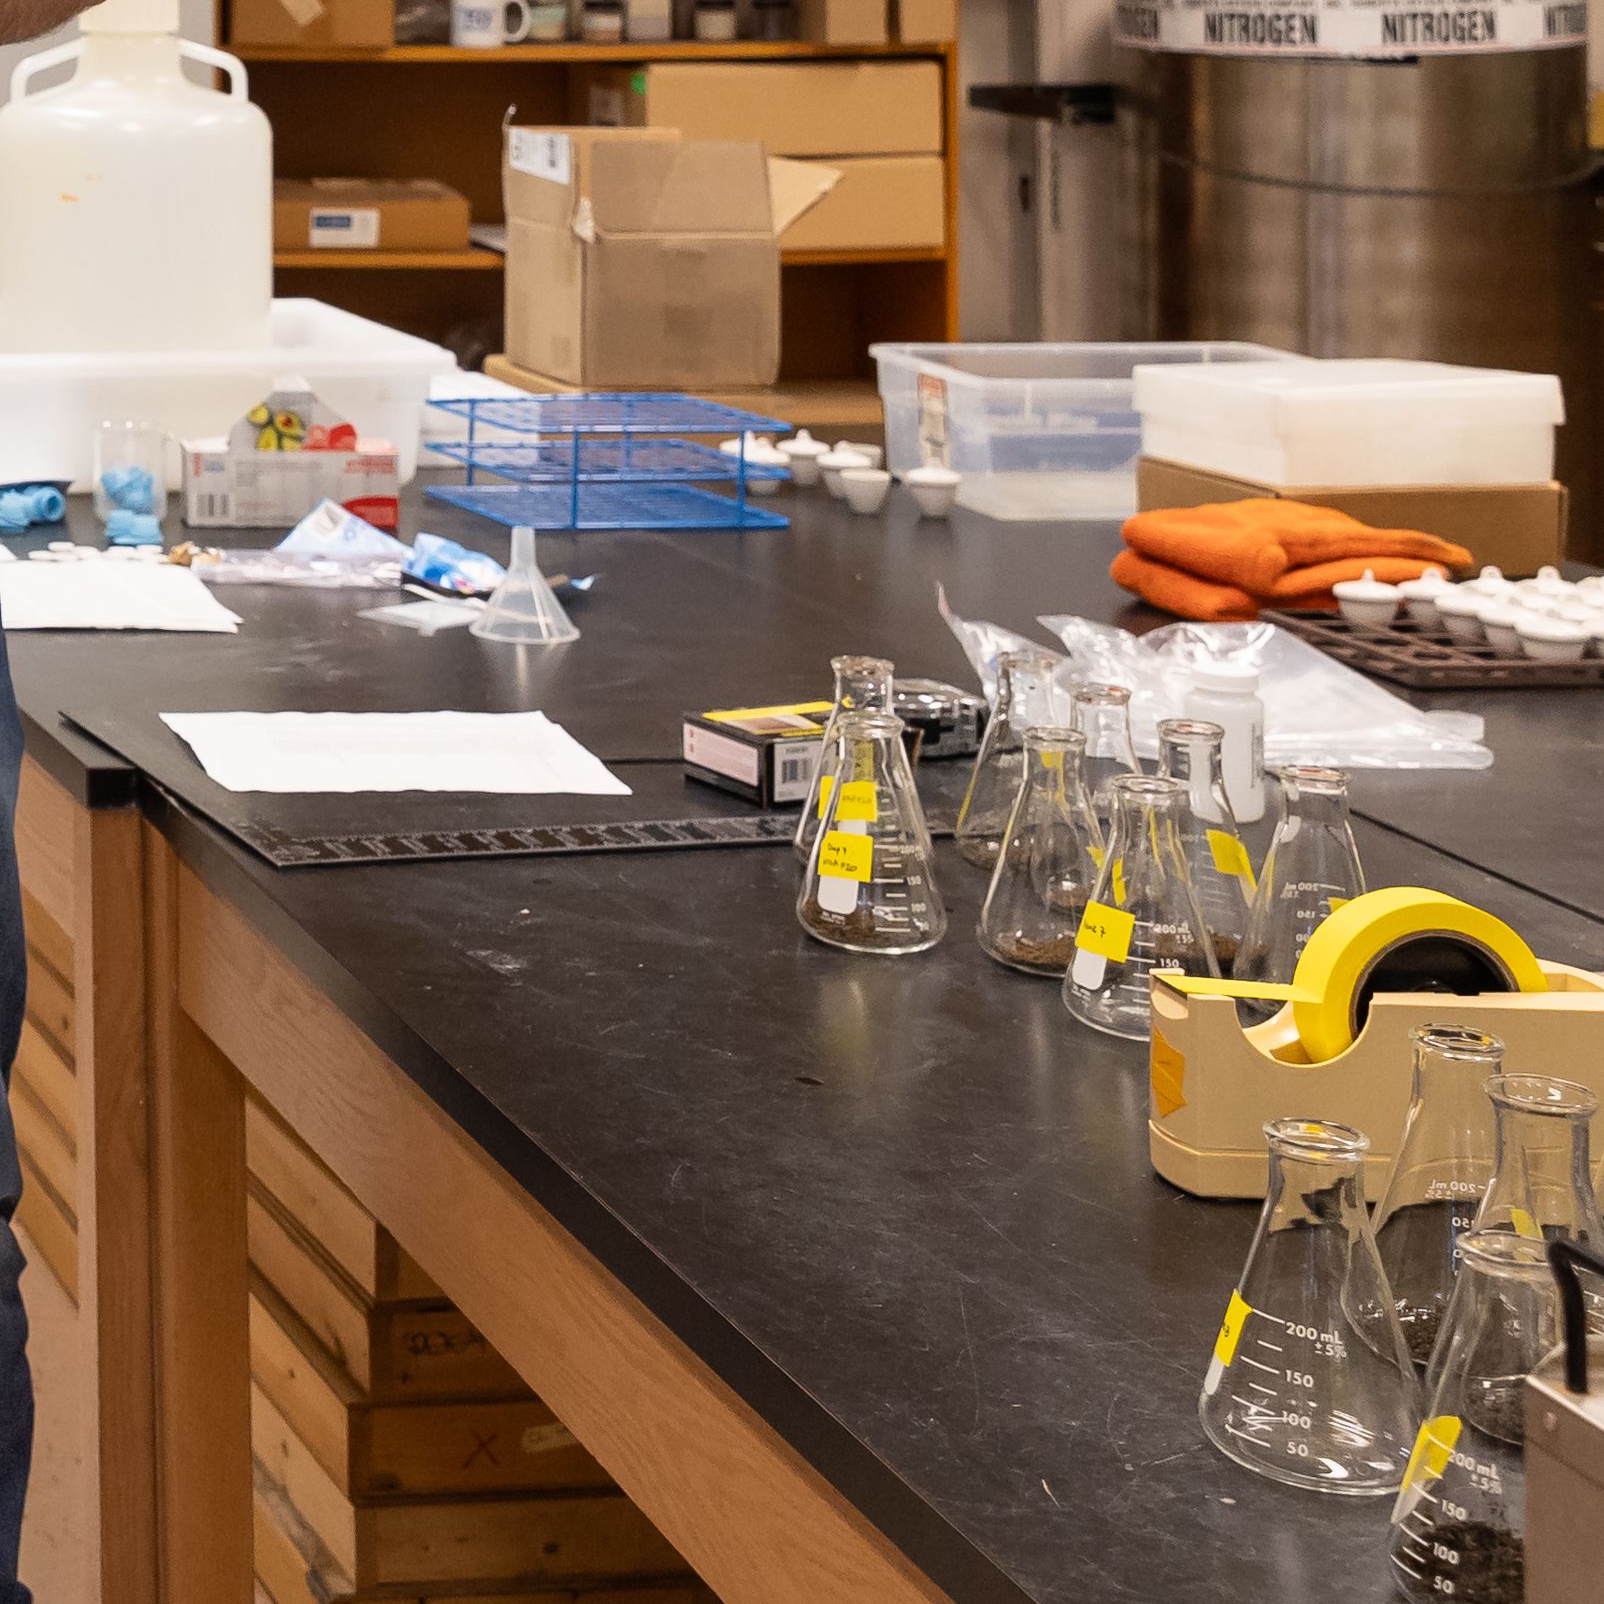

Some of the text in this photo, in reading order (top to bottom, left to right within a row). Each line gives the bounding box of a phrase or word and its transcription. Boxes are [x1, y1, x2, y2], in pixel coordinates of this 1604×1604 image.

[1204, 12, 1319, 44] NITROGEN
[1382, 10, 1497, 44] NITROGEN
[1160, 958, 1179, 967] 150
[1286, 1322, 1343, 1345] 200 mL
[1286, 1369, 1314, 1388] 150
[1282, 1410, 1311, 1429] 100
[1286, 1441, 1309, 1457] 50
[1449, 1451, 1501, 1480] 200 mL
[1442, 1499, 1468, 1521] 150
[1433, 1542, 1460, 1565] 100
[1433, 1575, 1455, 1594] 50
